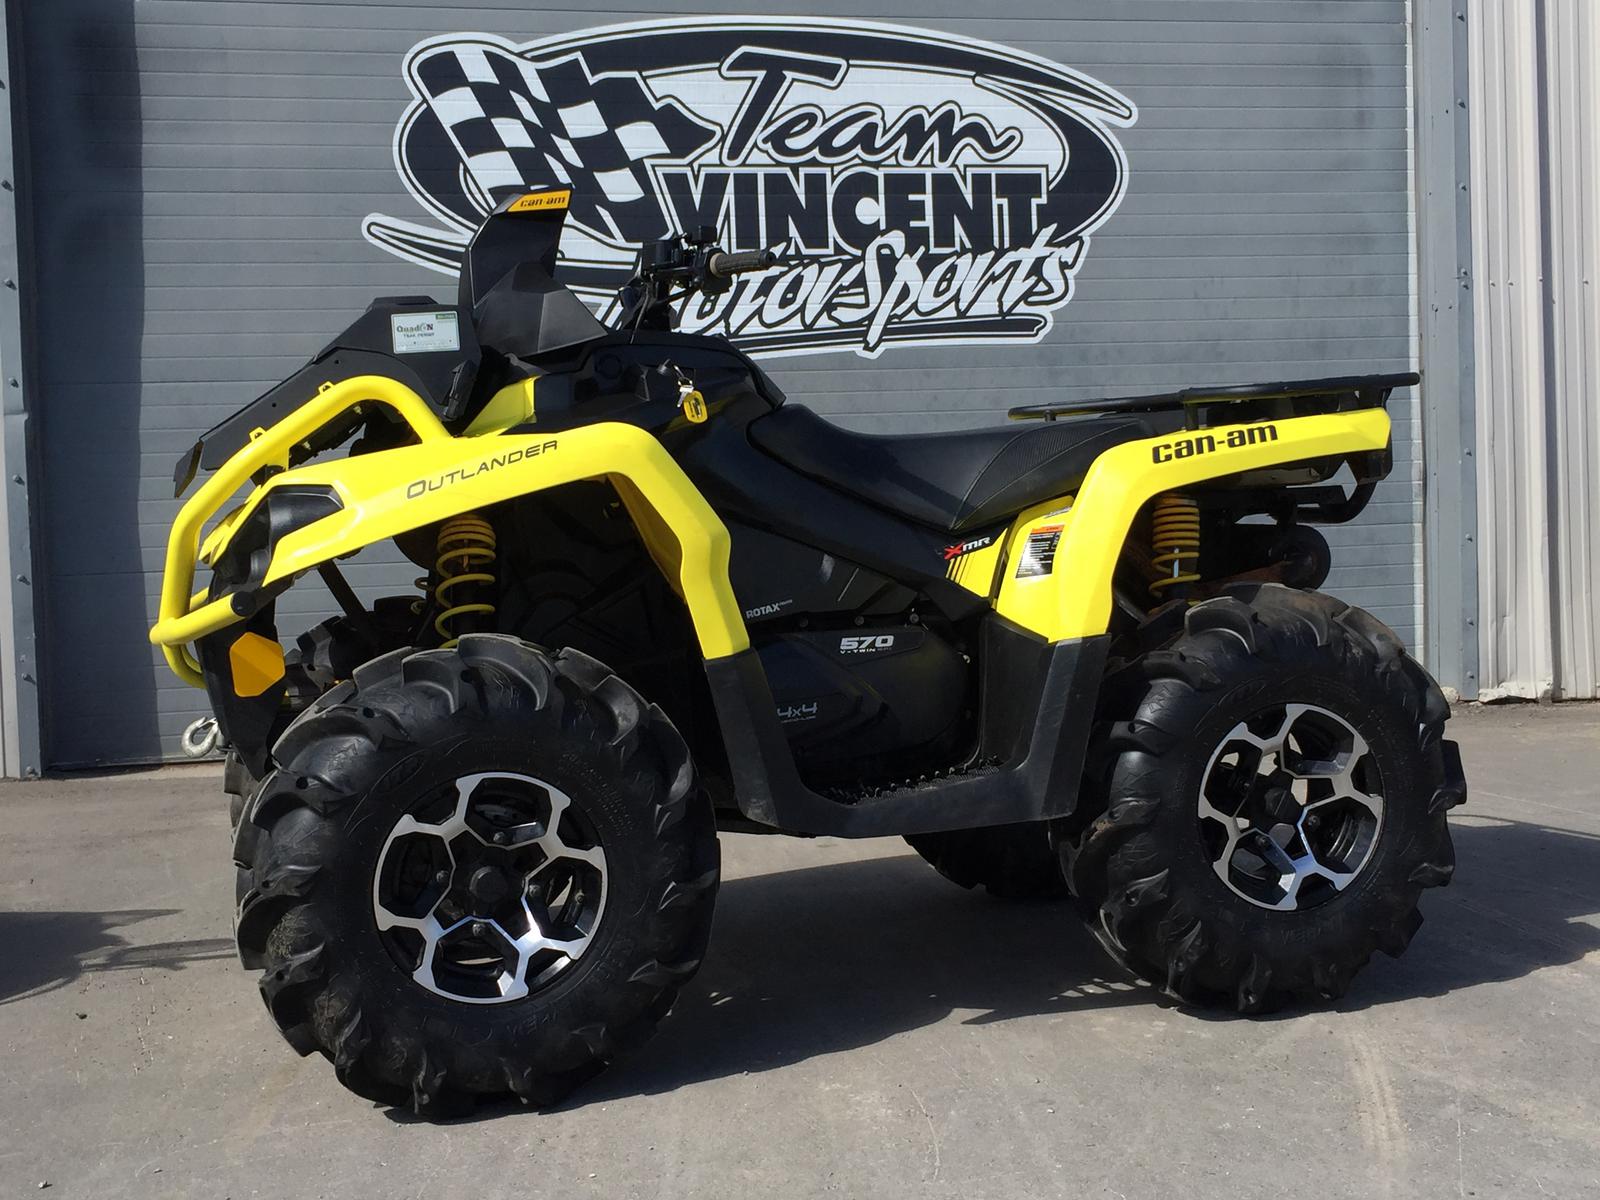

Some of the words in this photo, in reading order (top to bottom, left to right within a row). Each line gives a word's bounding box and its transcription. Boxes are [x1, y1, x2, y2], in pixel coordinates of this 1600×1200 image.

[720, 46, 1021, 164] Team
[661, 168, 1048, 254] VINCENT
[1152, 424, 1278, 464] can-am
[407, 440, 558, 499] OUTLANDER
[746, 603, 781, 619] ROTAX
[840, 635, 894, 650] 570
[776, 702, 817, 718] 4x4
